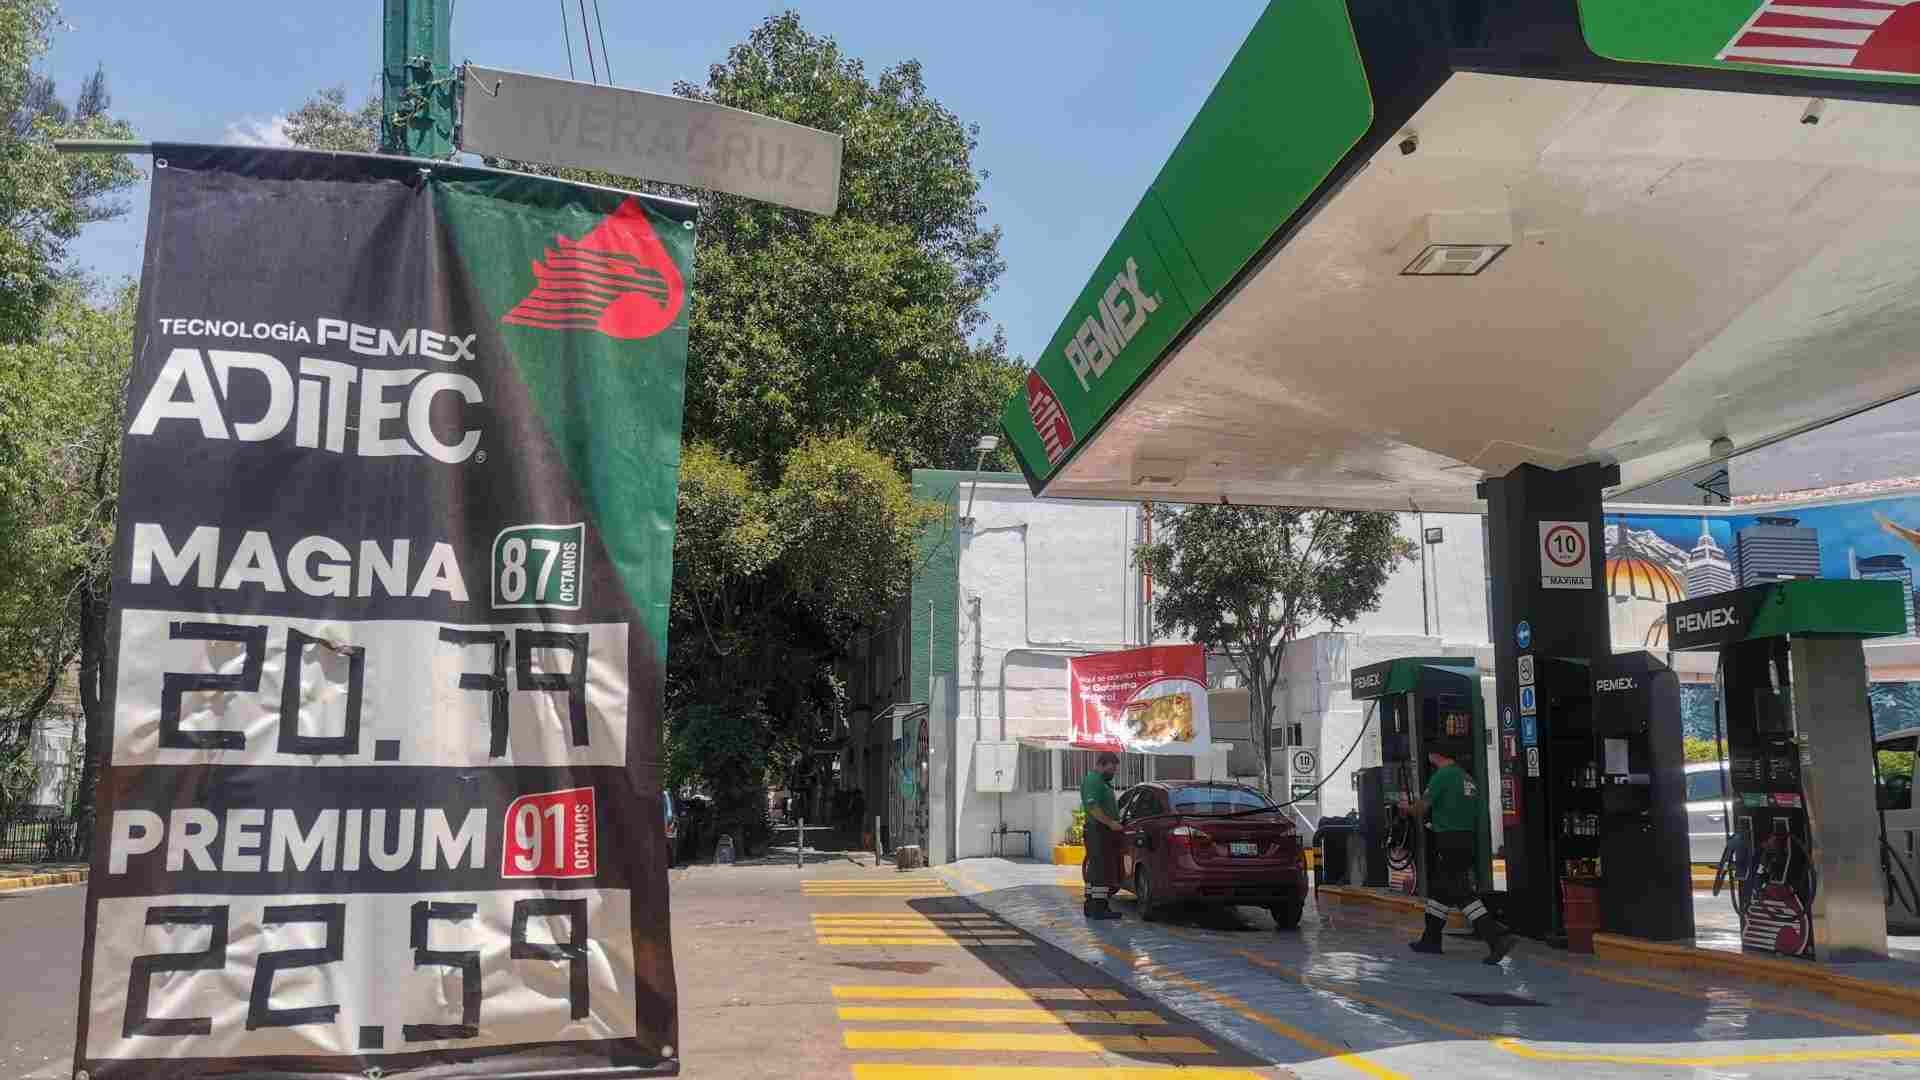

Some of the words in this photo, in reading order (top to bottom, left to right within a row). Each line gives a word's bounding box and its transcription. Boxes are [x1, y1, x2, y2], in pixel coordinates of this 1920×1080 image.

[159, 318, 311, 343] TECNOLOGÍA
[317, 318, 477, 361] PEMEX
[1064, 256, 1160, 392] PEMEX
[131, 523, 469, 601] MAGNA
[501, 537, 560, 601] 87
[560, 541, 577, 602] OCTANOS
[1552, 535, 1576, 553] 10
[1675, 606, 1736, 633] PEMEX
[158, 621, 589, 761] 20.79
[1596, 678, 1632, 691] PEMEX
[108, 808, 487, 875] PREMIUM
[514, 803, 565, 872] 91
[574, 804, 590, 869] OCTANOS
[123, 898, 590, 1048] 22.59
